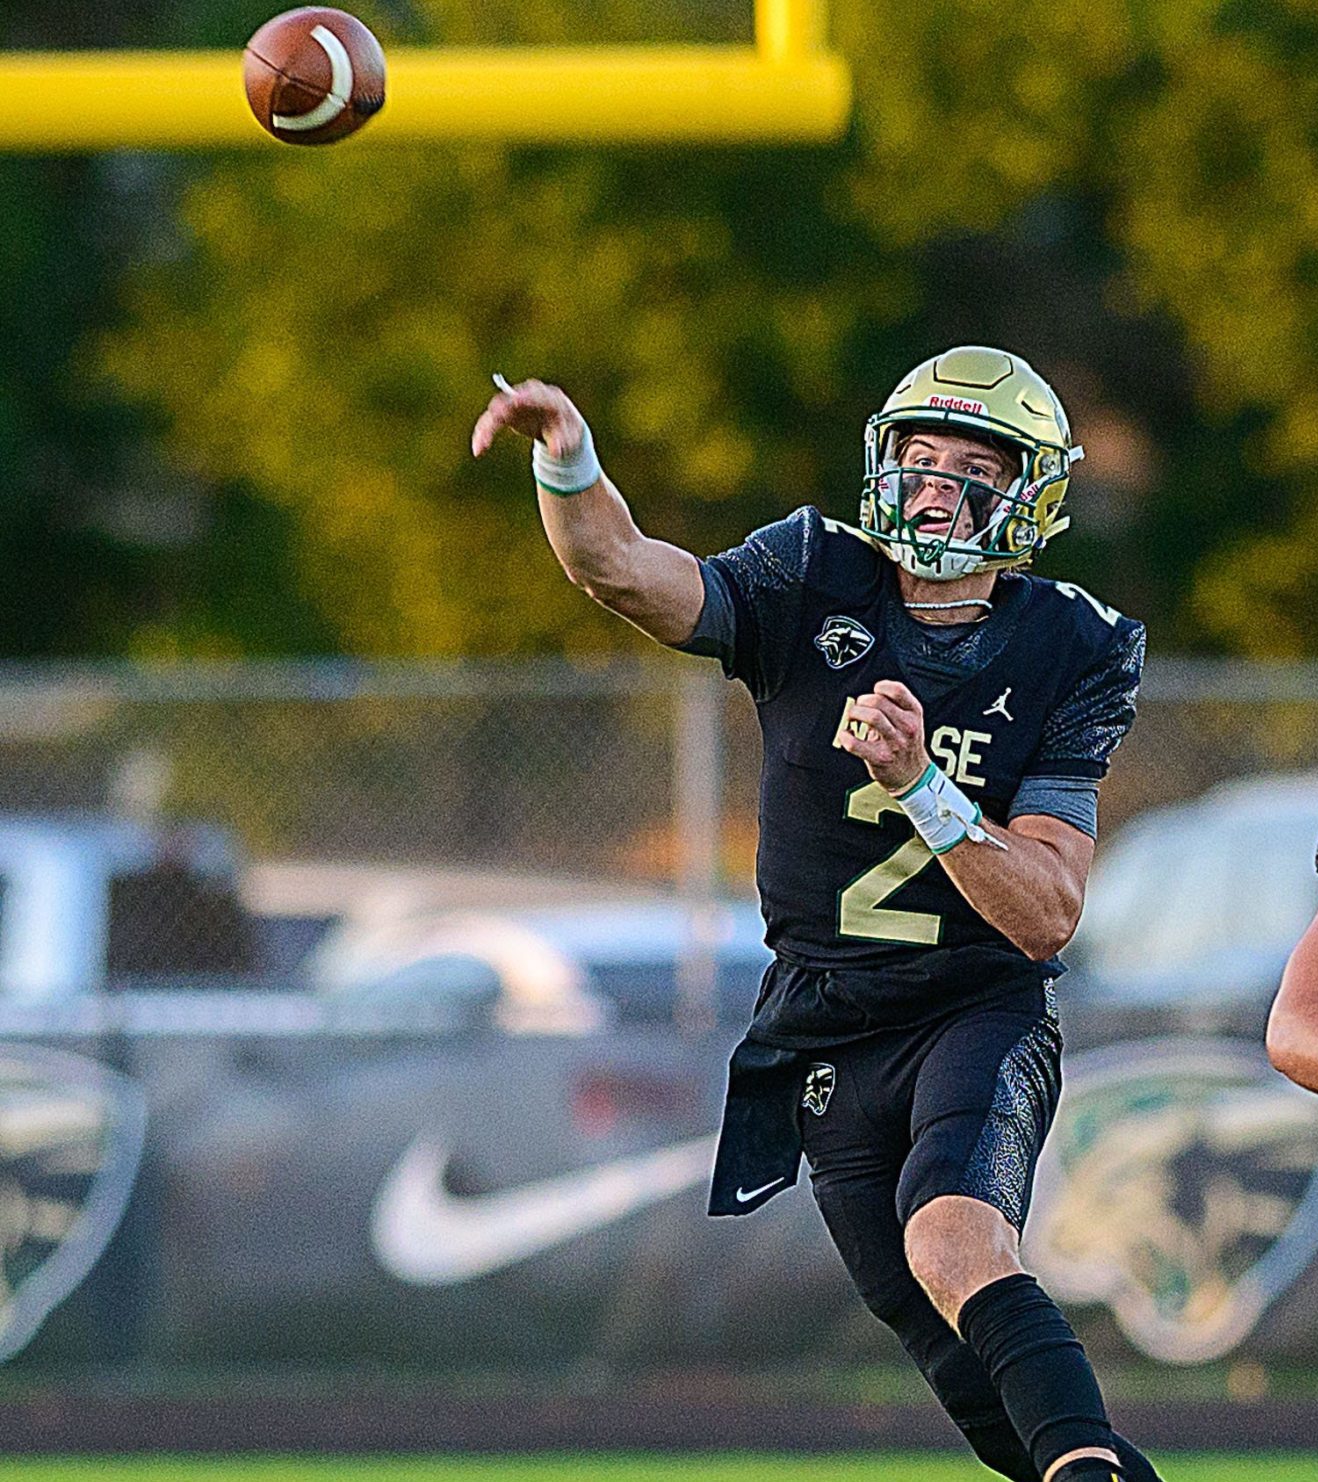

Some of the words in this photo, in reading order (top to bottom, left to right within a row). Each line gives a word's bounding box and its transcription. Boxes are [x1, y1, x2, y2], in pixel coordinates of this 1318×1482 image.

[929, 396, 982, 415] Riddell
[832, 696, 992, 787] NSE
[836, 779, 945, 948] 2
